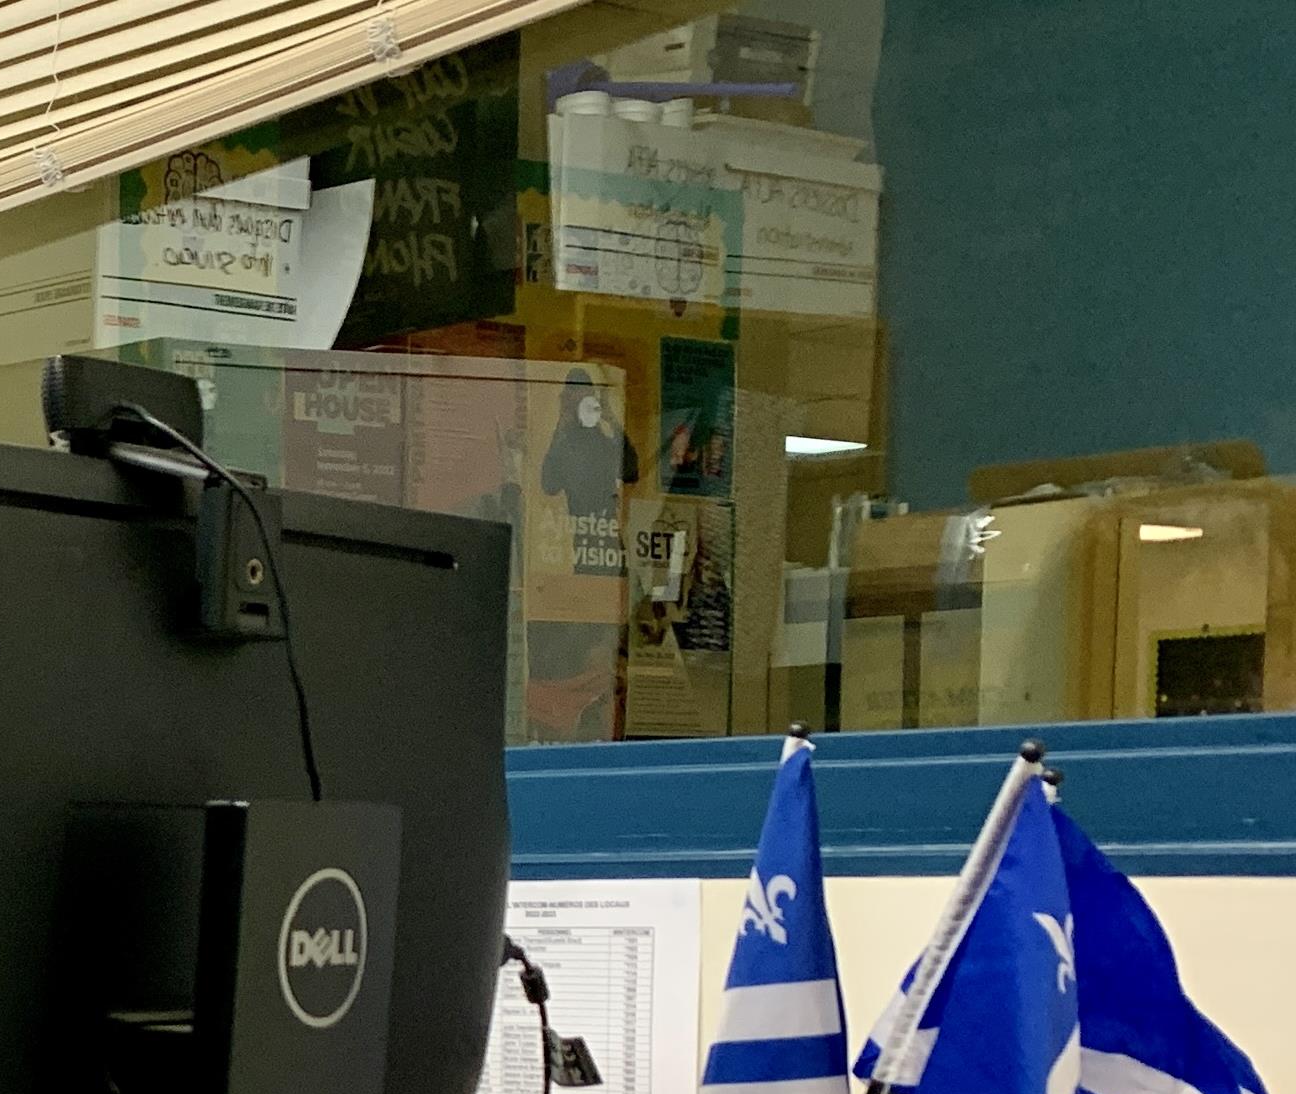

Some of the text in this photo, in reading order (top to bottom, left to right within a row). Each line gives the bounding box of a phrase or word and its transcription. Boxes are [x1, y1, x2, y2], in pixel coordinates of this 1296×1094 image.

[305, 392, 392, 424] HOUSE
[636, 530, 675, 560] SET
[289, 927, 358, 968] DELL
